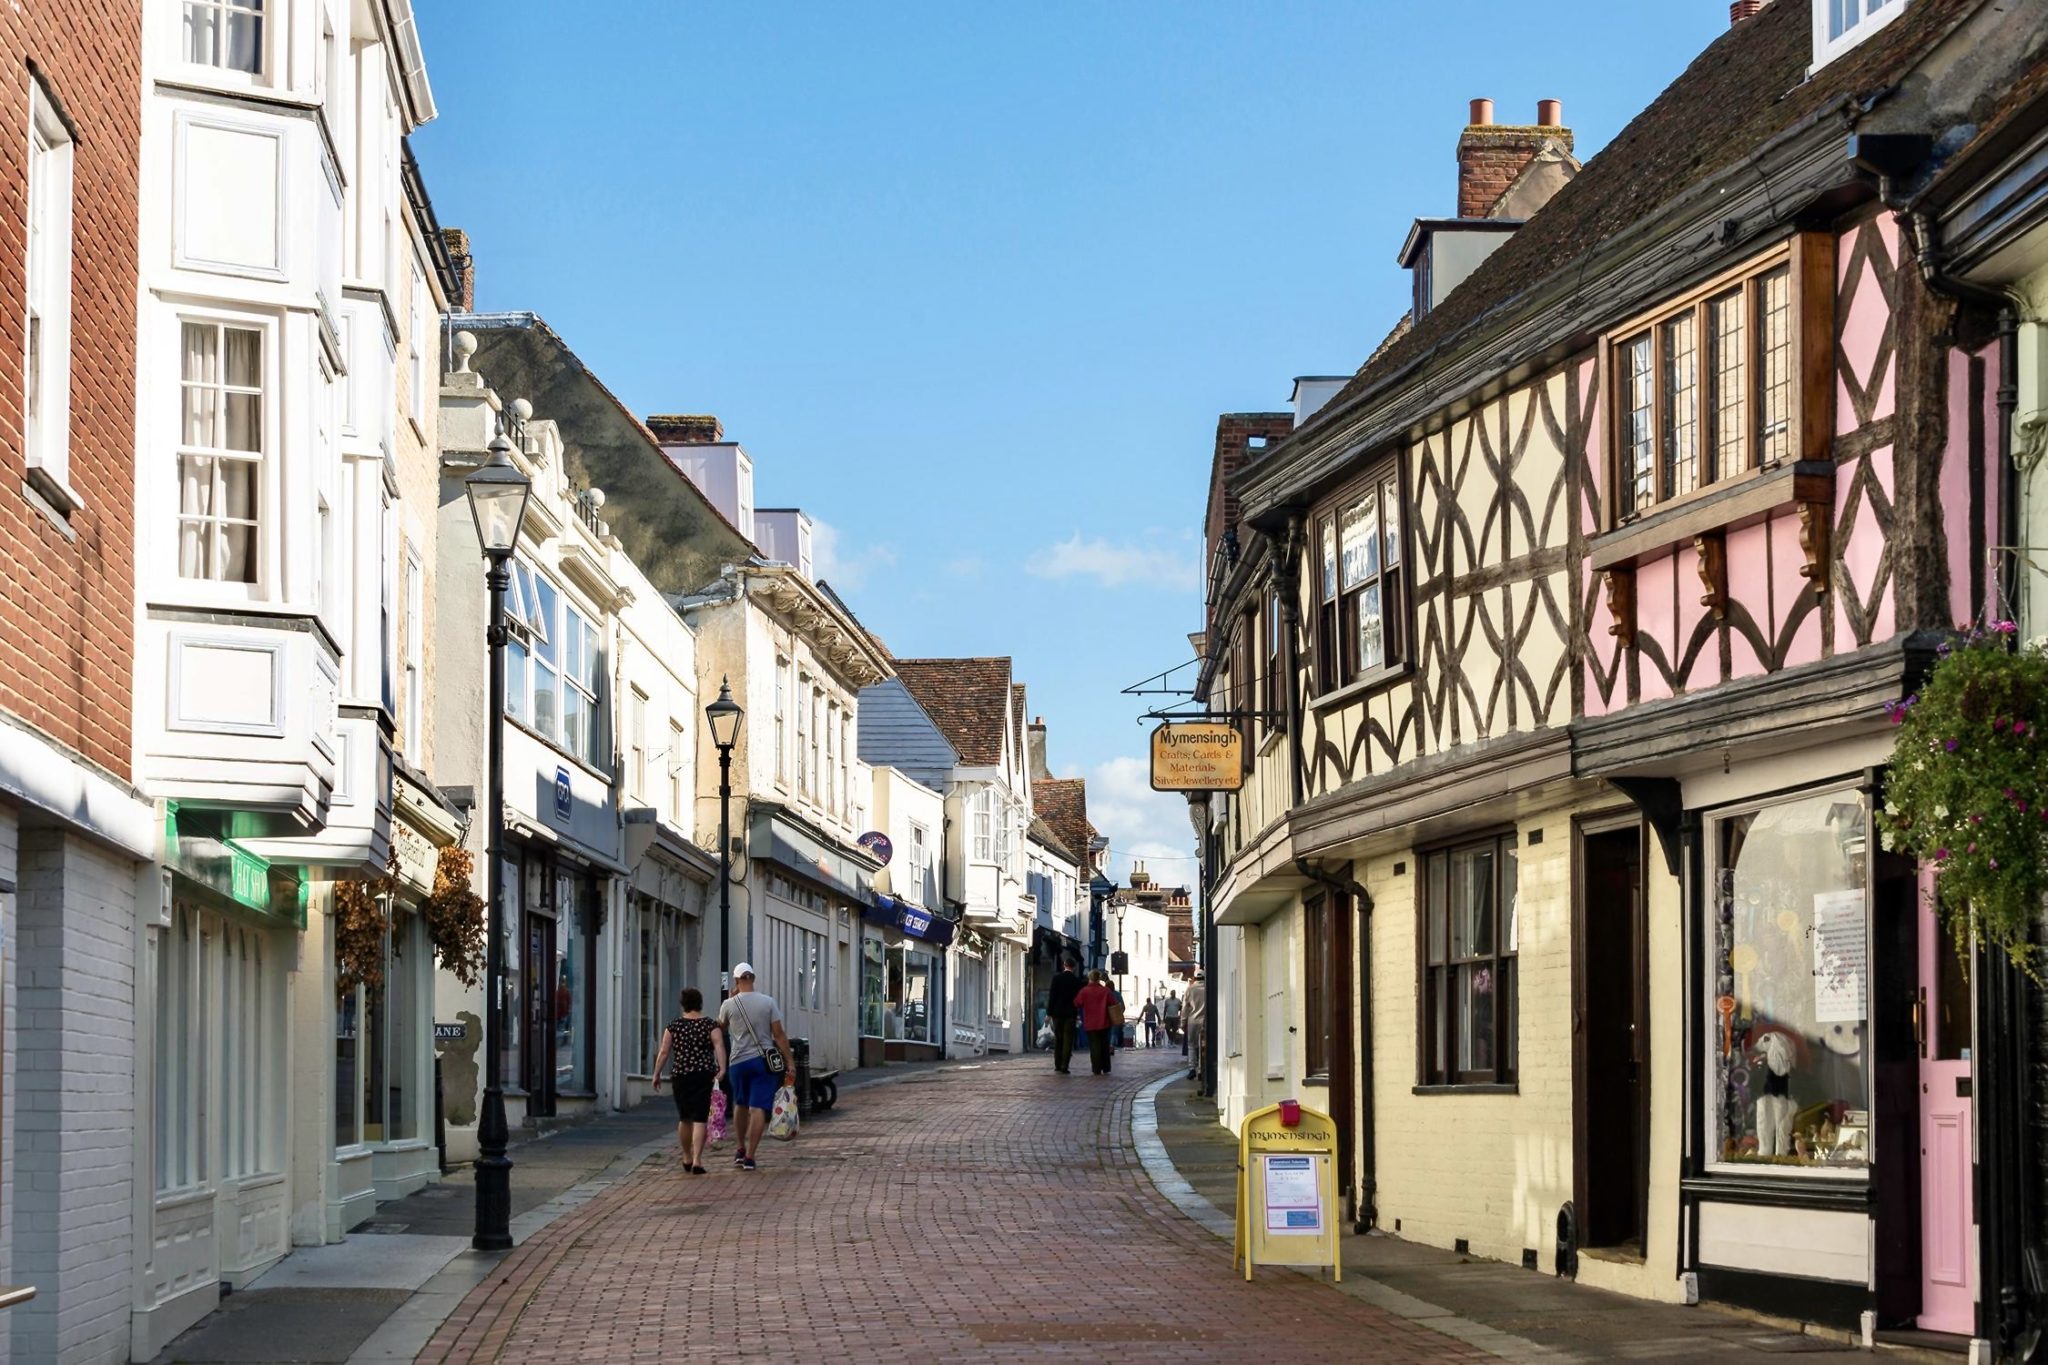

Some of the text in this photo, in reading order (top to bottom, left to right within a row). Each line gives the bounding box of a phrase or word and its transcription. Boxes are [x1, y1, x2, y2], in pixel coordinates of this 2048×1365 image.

[1160, 730, 1237, 747] Mymensingh
[1193, 750, 1222, 760] Cards
[1225, 750, 1233, 759] &
[1170, 763, 1216, 773] Materials
[1155, 776, 1180, 785] Silver
[1183, 775, 1223, 786] Jewellery
[237, 859, 251, 898] HAT
[436, 1026, 461, 1037] ANE
